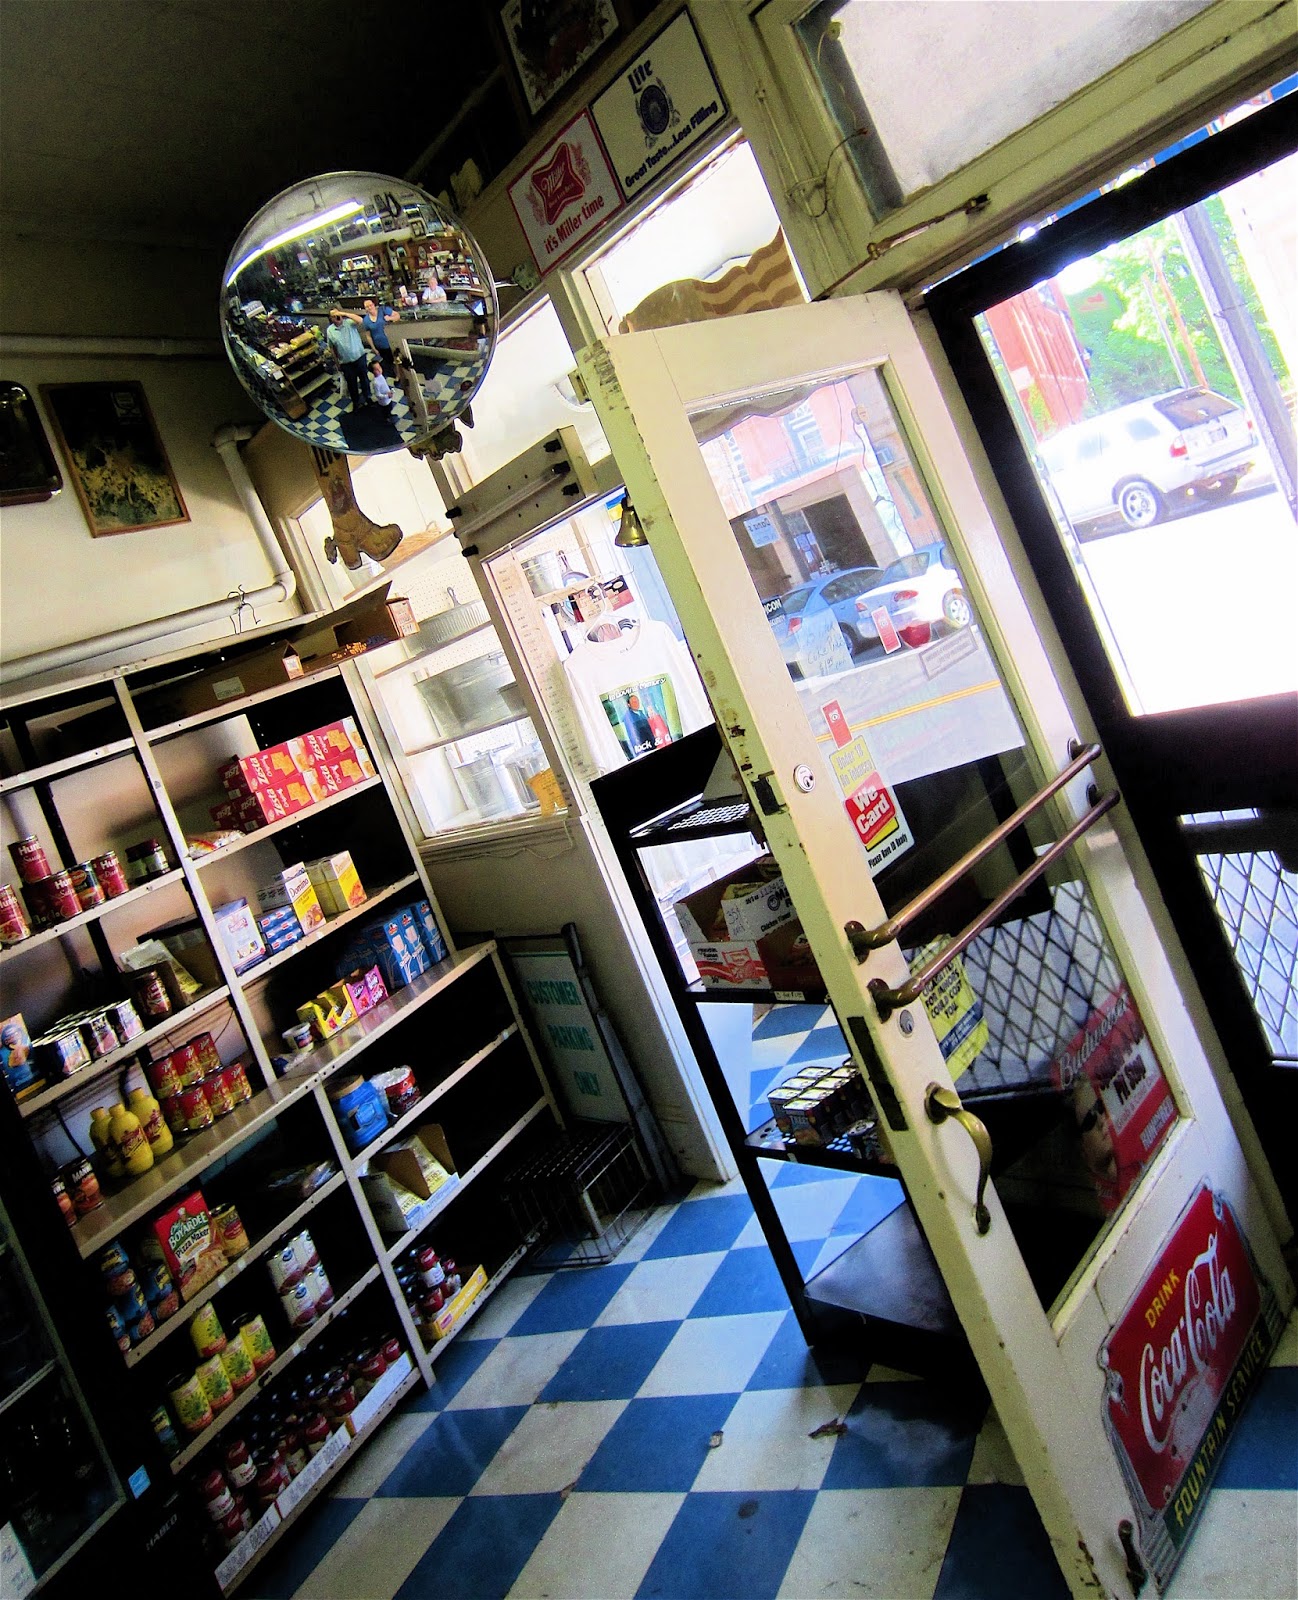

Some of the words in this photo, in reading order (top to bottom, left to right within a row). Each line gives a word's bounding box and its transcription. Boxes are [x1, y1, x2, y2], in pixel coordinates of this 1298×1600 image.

[627, 59, 653, 94] Lite
[625, 163, 648, 188] Great
[690, 101, 718, 129] Filling
[544, 235, 559, 254] it's
[556, 214, 582, 243] Miller
[581, 195, 605, 219] time
[307, 734, 326, 761] Zesta
[250, 757, 270, 785] Zesta
[320, 765, 338, 791] Zesta
[267, 788, 286, 816] Zesta
[852, 783, 879, 813] We
[856, 793, 890, 835] Card
[868, 854, 883, 868] Please
[881, 847, 892, 859] Have
[895, 833, 908, 848] Ready
[289, 878, 309, 898] Domino
[760, 917, 778, 932] Chicken
[526, 980, 583, 1005] CUSTOMER
[925, 991, 939, 1008] FOR
[937, 969, 960, 996] MINORS
[931, 996, 950, 1019] COULD
[948, 979, 962, 1000] COST
[945, 1004, 959, 1019] YOU
[547, 1024, 596, 1051] PARKING
[1058, 992, 1127, 1091] Budweiser
[168, 1211, 208, 1248] BOYARDEE
[175, 1239, 193, 1259] Pizza
[191, 1228, 210, 1244] Maker
[1144, 1267, 1180, 1329] DRINK
[1139, 1228, 1236, 1454] Coca-Cola
[1173, 1416, 1228, 1529] FOUNTAIN
[1225, 1330, 1269, 1417] SERVICE
